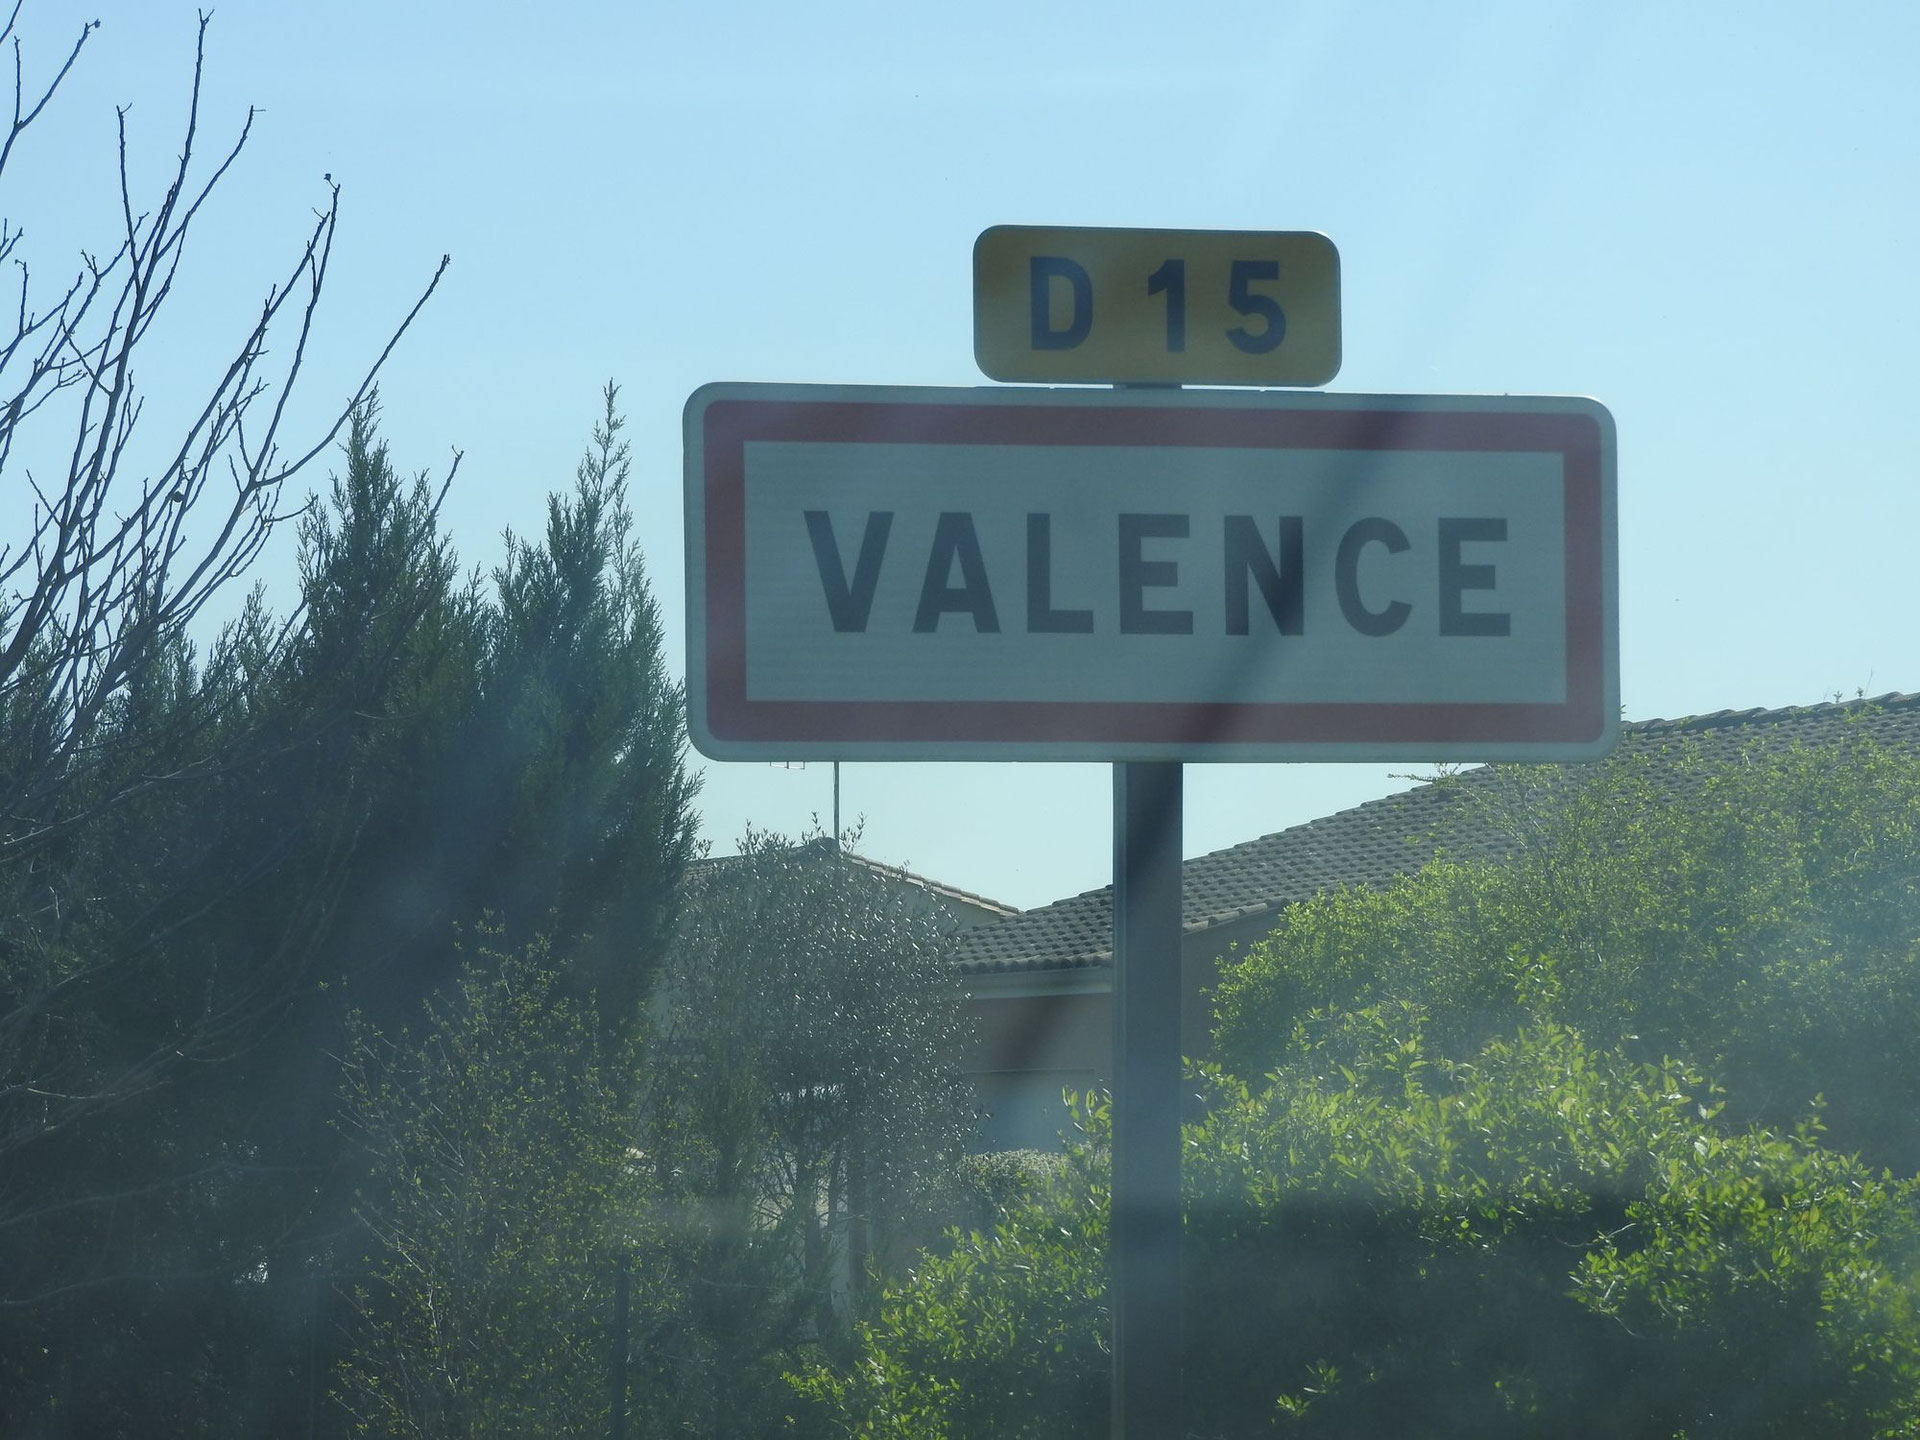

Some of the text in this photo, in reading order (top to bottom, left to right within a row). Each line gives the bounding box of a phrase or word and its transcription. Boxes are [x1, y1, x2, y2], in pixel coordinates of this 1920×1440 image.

[1030, 256, 1287, 355] D 15
[803, 510, 1512, 637] VALENCE
